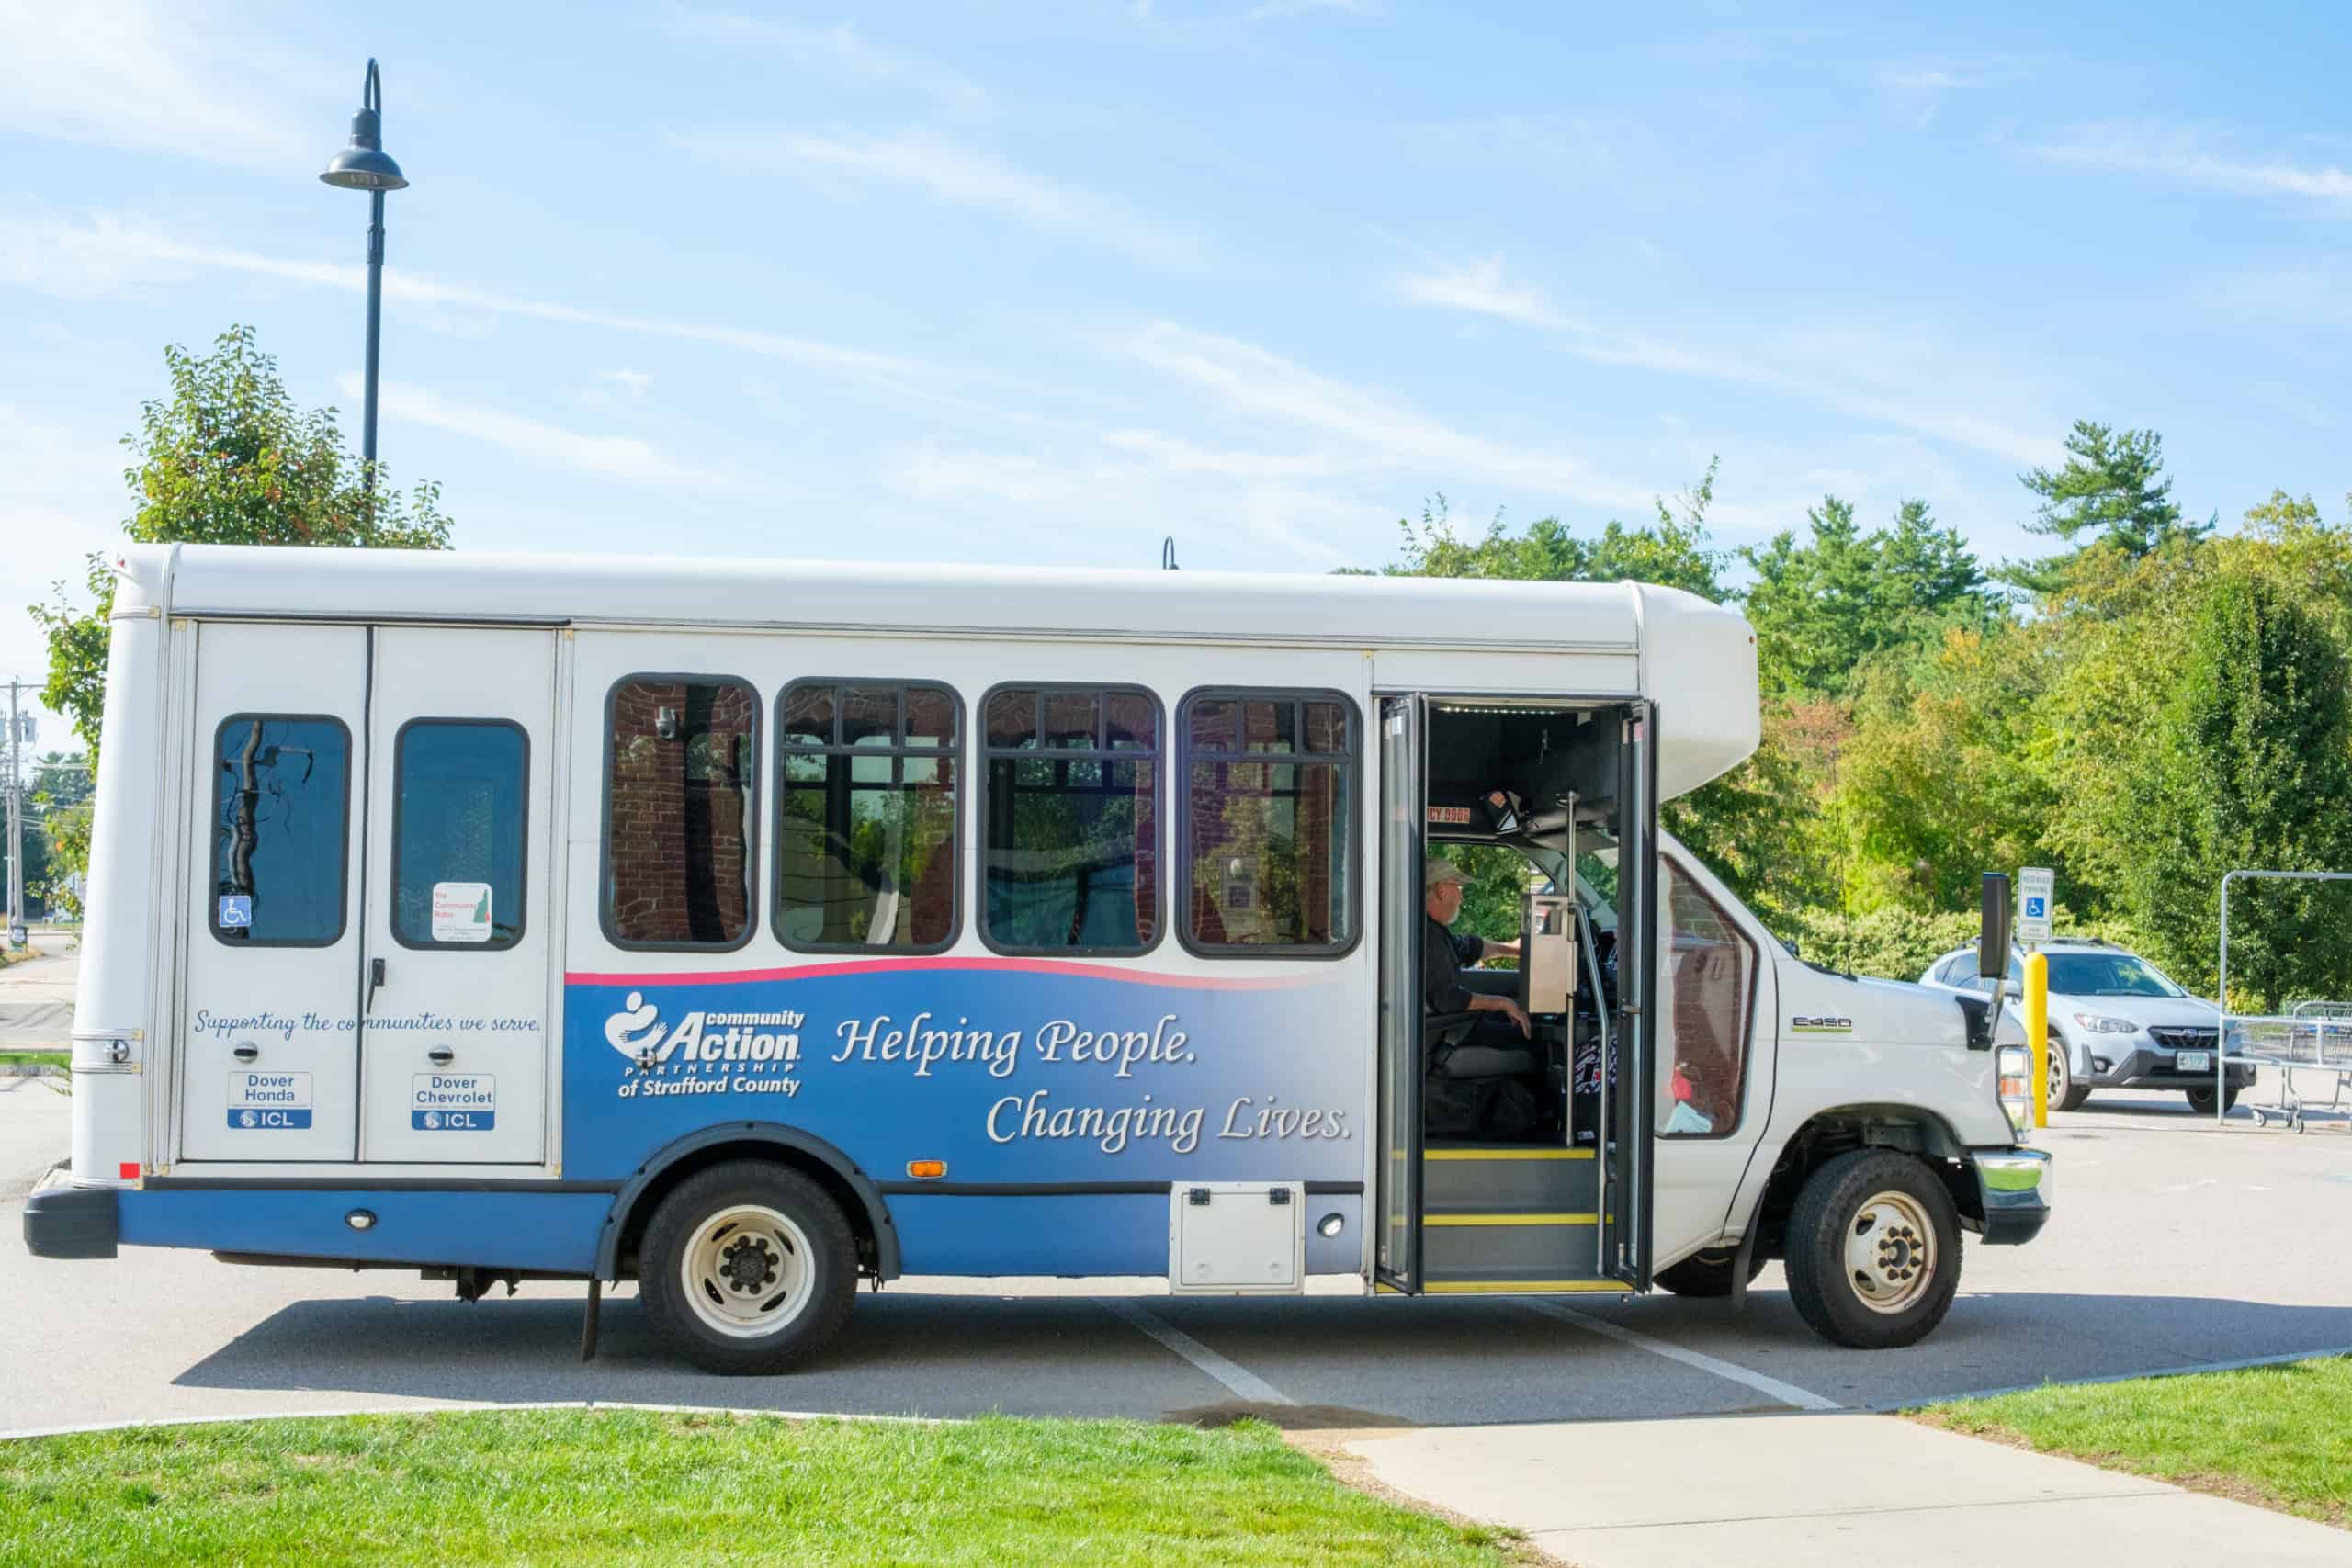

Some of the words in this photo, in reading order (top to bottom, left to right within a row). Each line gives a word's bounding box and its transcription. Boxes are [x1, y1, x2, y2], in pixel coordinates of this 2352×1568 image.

[194, 1010, 296, 1041] Supporting
[302, 1013, 332, 1031] the
[459, 1019, 487, 1031] we
[492, 1018, 540, 1031] serve.
[706, 1011, 805, 1029] community
[831, 1013, 1022, 1077] Helping
[1036, 1014, 1196, 1077] People.
[625, 1063, 796, 1077] PARTNERSHIP
[248, 1075, 294, 1088] Dover
[432, 1077, 477, 1089] Dover
[618, 1079, 638, 1098] of
[643, 1077, 726, 1096] Strafford
[733, 1077, 801, 1097] County
[245, 1089, 295, 1102] Honda
[416, 1090, 492, 1104] Chevrolet
[261, 1112, 294, 1126] ICL
[445, 1114, 477, 1128] ICL
[986, 1089, 1204, 1154] Changing
[1216, 1095, 1352, 1140] Lives.
